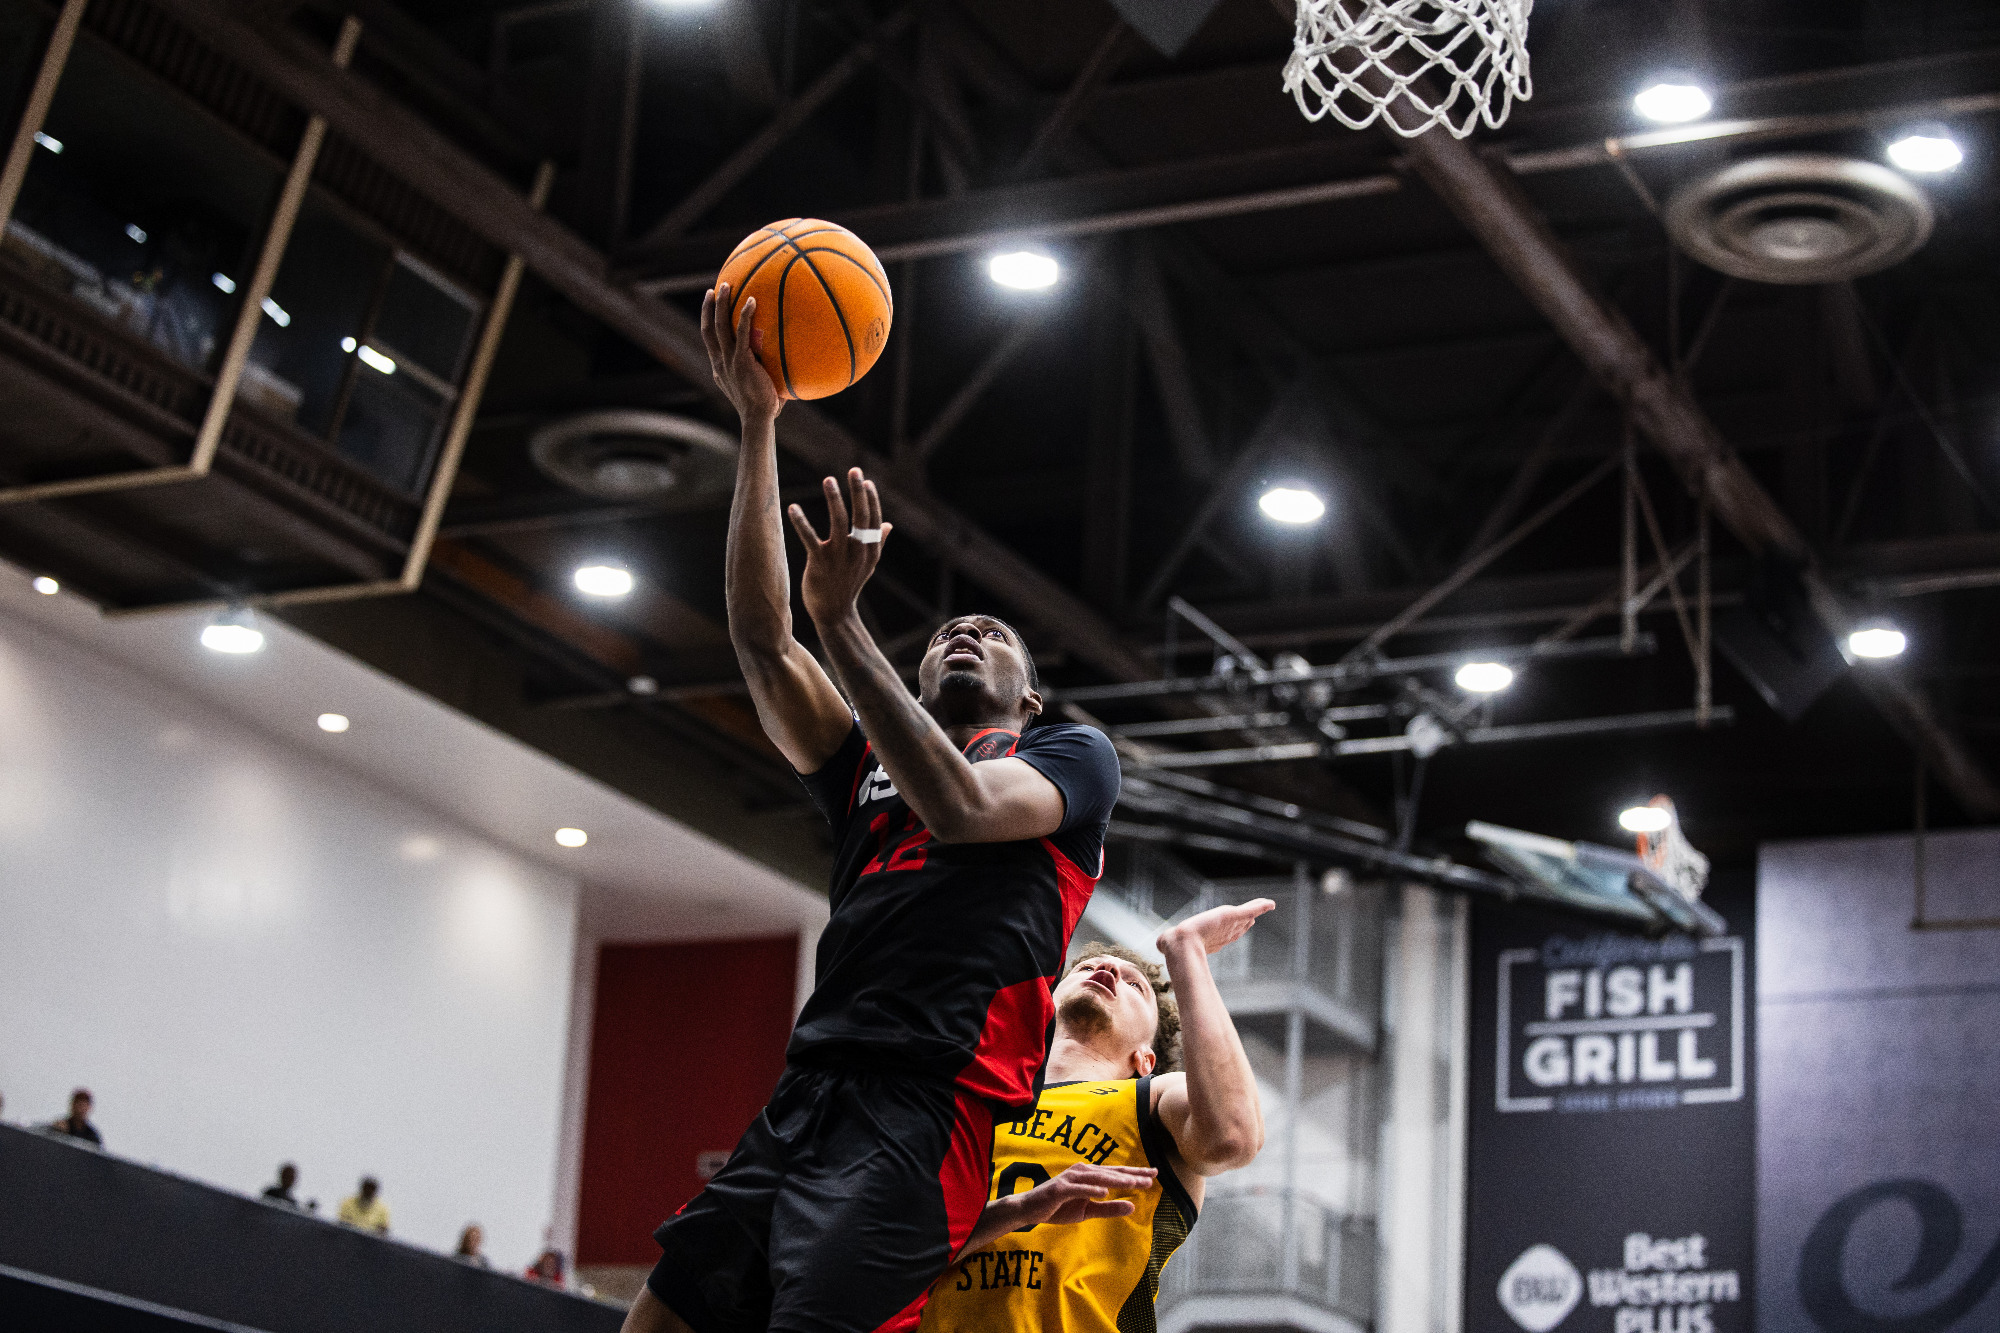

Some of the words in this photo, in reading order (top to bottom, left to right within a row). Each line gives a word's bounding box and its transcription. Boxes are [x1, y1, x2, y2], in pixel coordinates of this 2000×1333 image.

[1546, 963, 1694, 1018] FISH
[1523, 1030, 1717, 1086] GRILL
[1009, 1109, 1119, 1164] BEACH
[956, 1250, 1043, 1291] STATE
[1624, 1232, 1707, 1270] Best
[1588, 1268, 1740, 1307] Western
